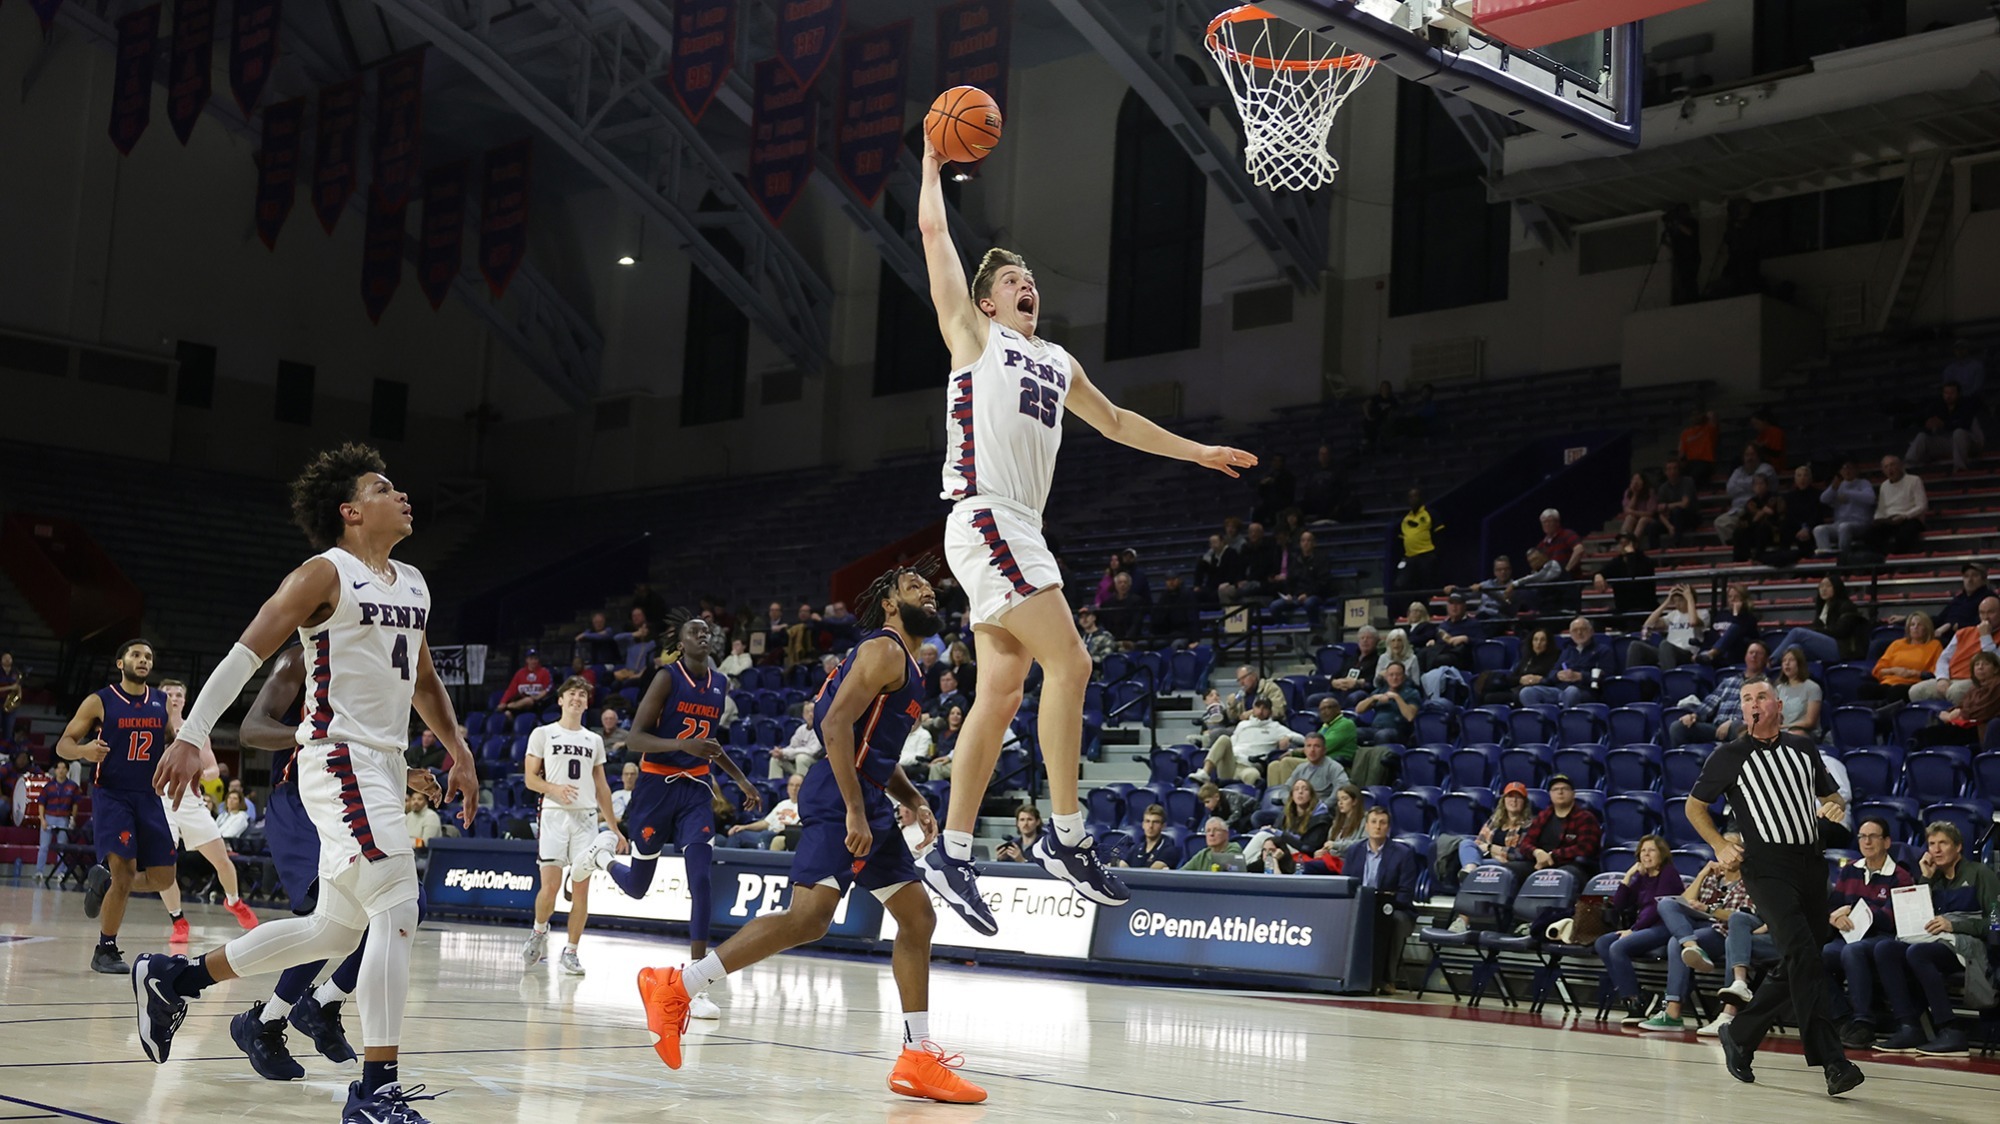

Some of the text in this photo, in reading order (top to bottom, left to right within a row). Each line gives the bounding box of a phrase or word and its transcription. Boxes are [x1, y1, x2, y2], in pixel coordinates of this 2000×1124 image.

[1004, 349, 1066, 392] PENN
[1019, 377, 1059, 429] 25
[359, 602, 426, 631] PENN
[1350, 607, 1365, 618] 115
[391, 634, 410, 681] 4
[118, 718, 162, 728] BUCKNELL
[677, 701, 720, 719] BUCKNELL
[127, 731, 153, 761] 12
[552, 745, 593, 759] PENN
[568, 759, 581, 780] 0
[445, 869, 533, 891] #FightOnPenn
[1011, 887, 1086, 919] Funds
[1129, 908, 1313, 946] @PennAthletics
